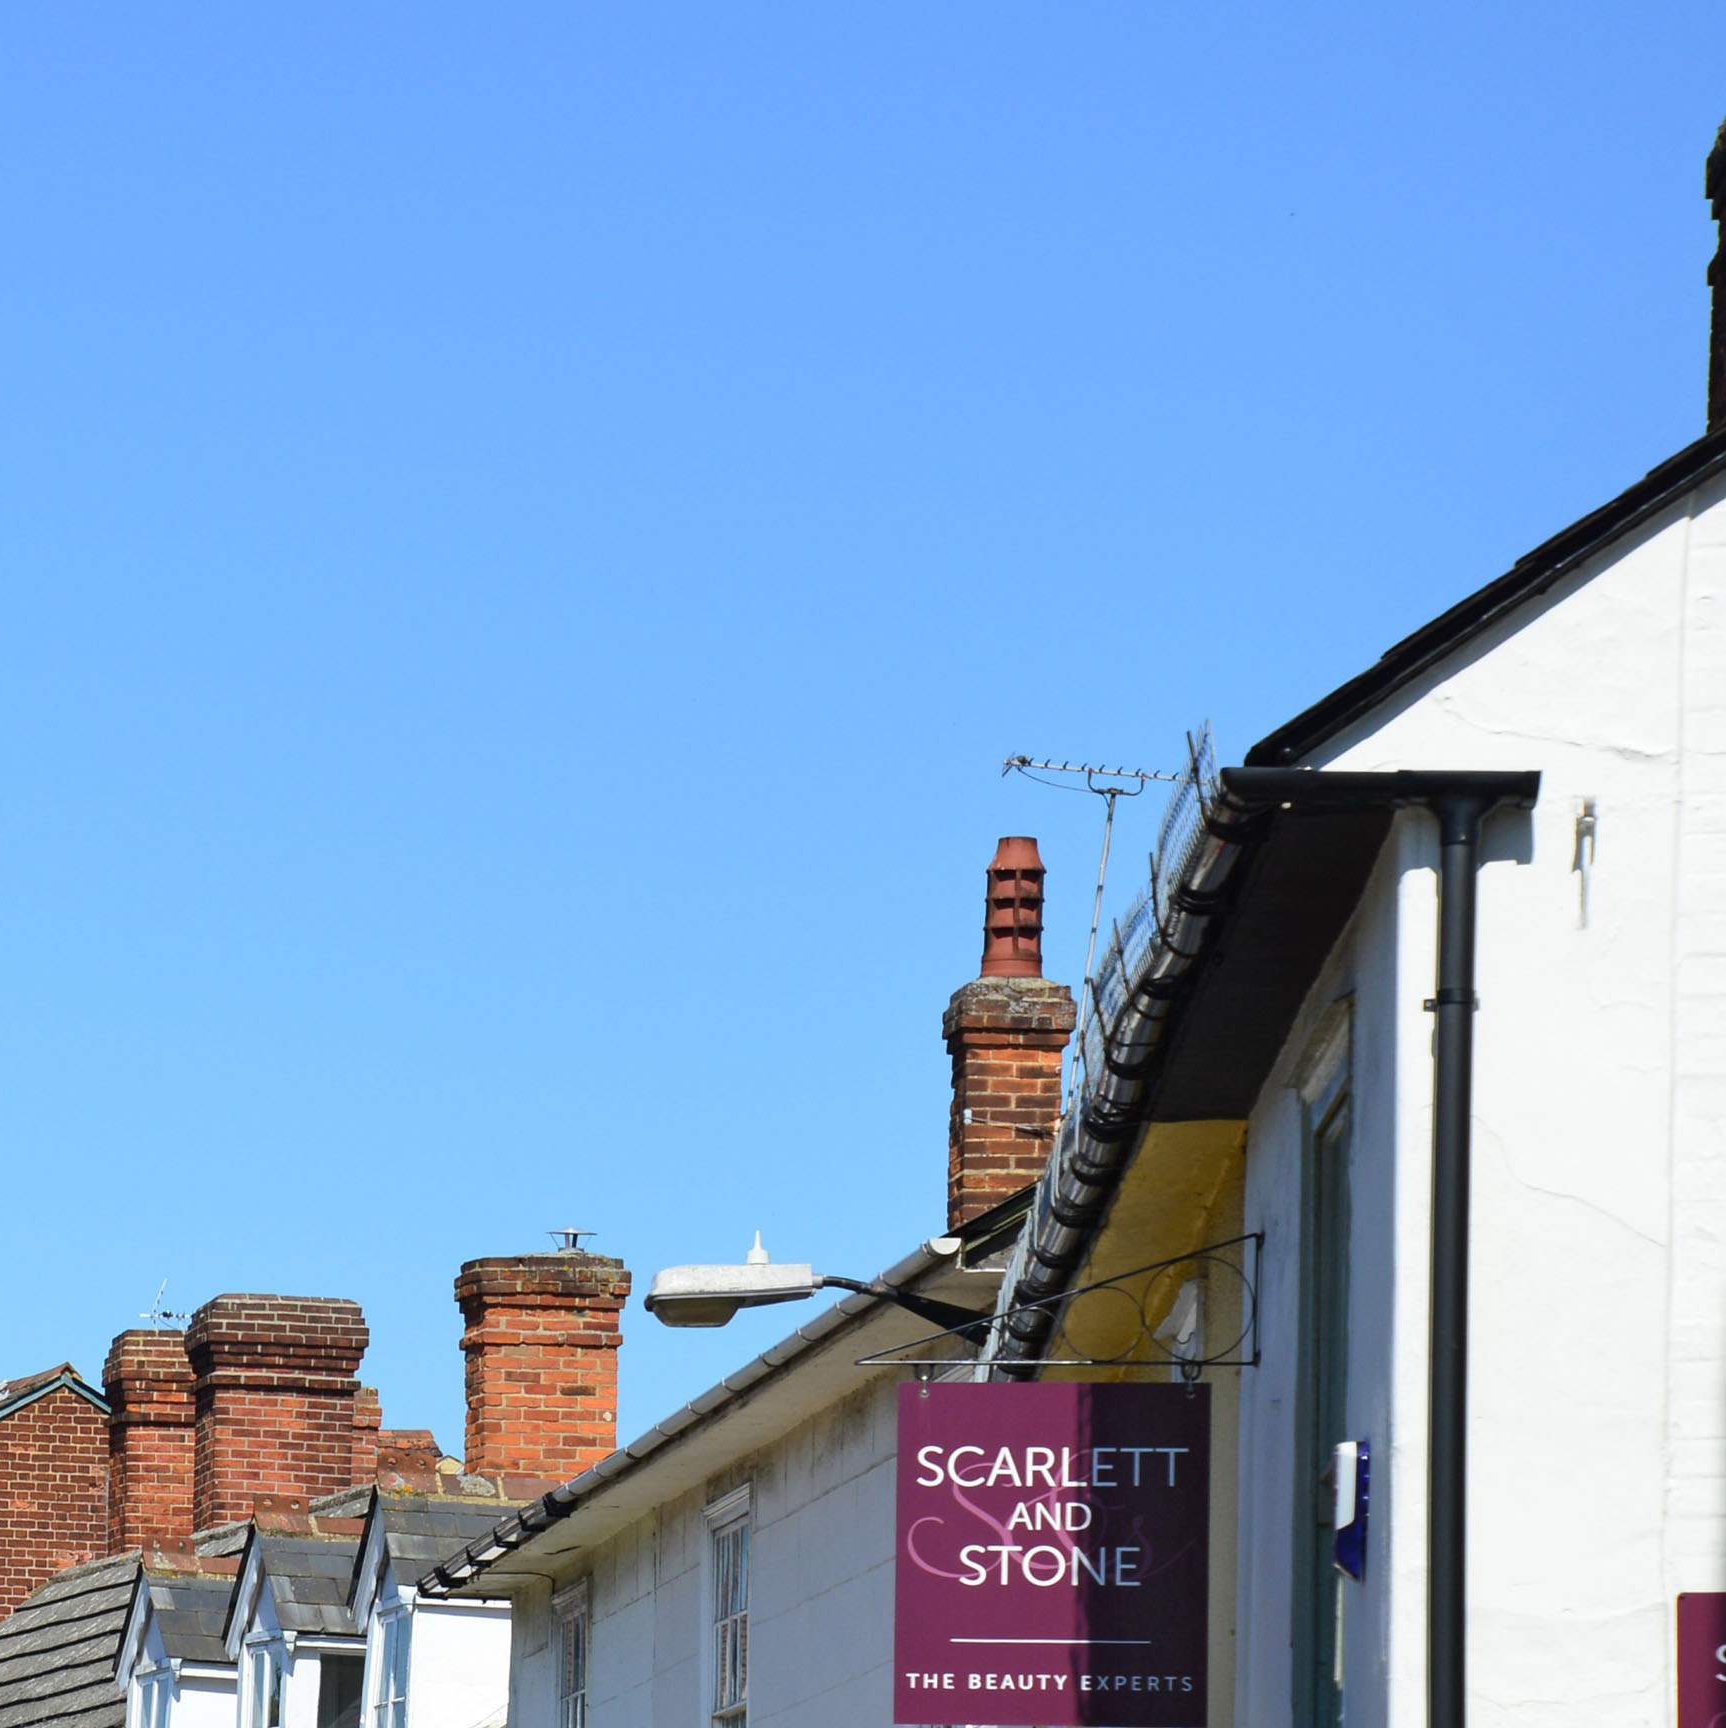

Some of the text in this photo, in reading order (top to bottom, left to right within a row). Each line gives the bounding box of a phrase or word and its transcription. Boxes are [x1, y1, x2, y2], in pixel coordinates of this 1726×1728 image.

[916, 1445, 1190, 1487] SCARLETT
[1007, 1501, 1093, 1532] AND
[958, 1544, 1142, 1587] STONE
[905, 1672, 1194, 1692] THE BEAUTY EXPERTS
